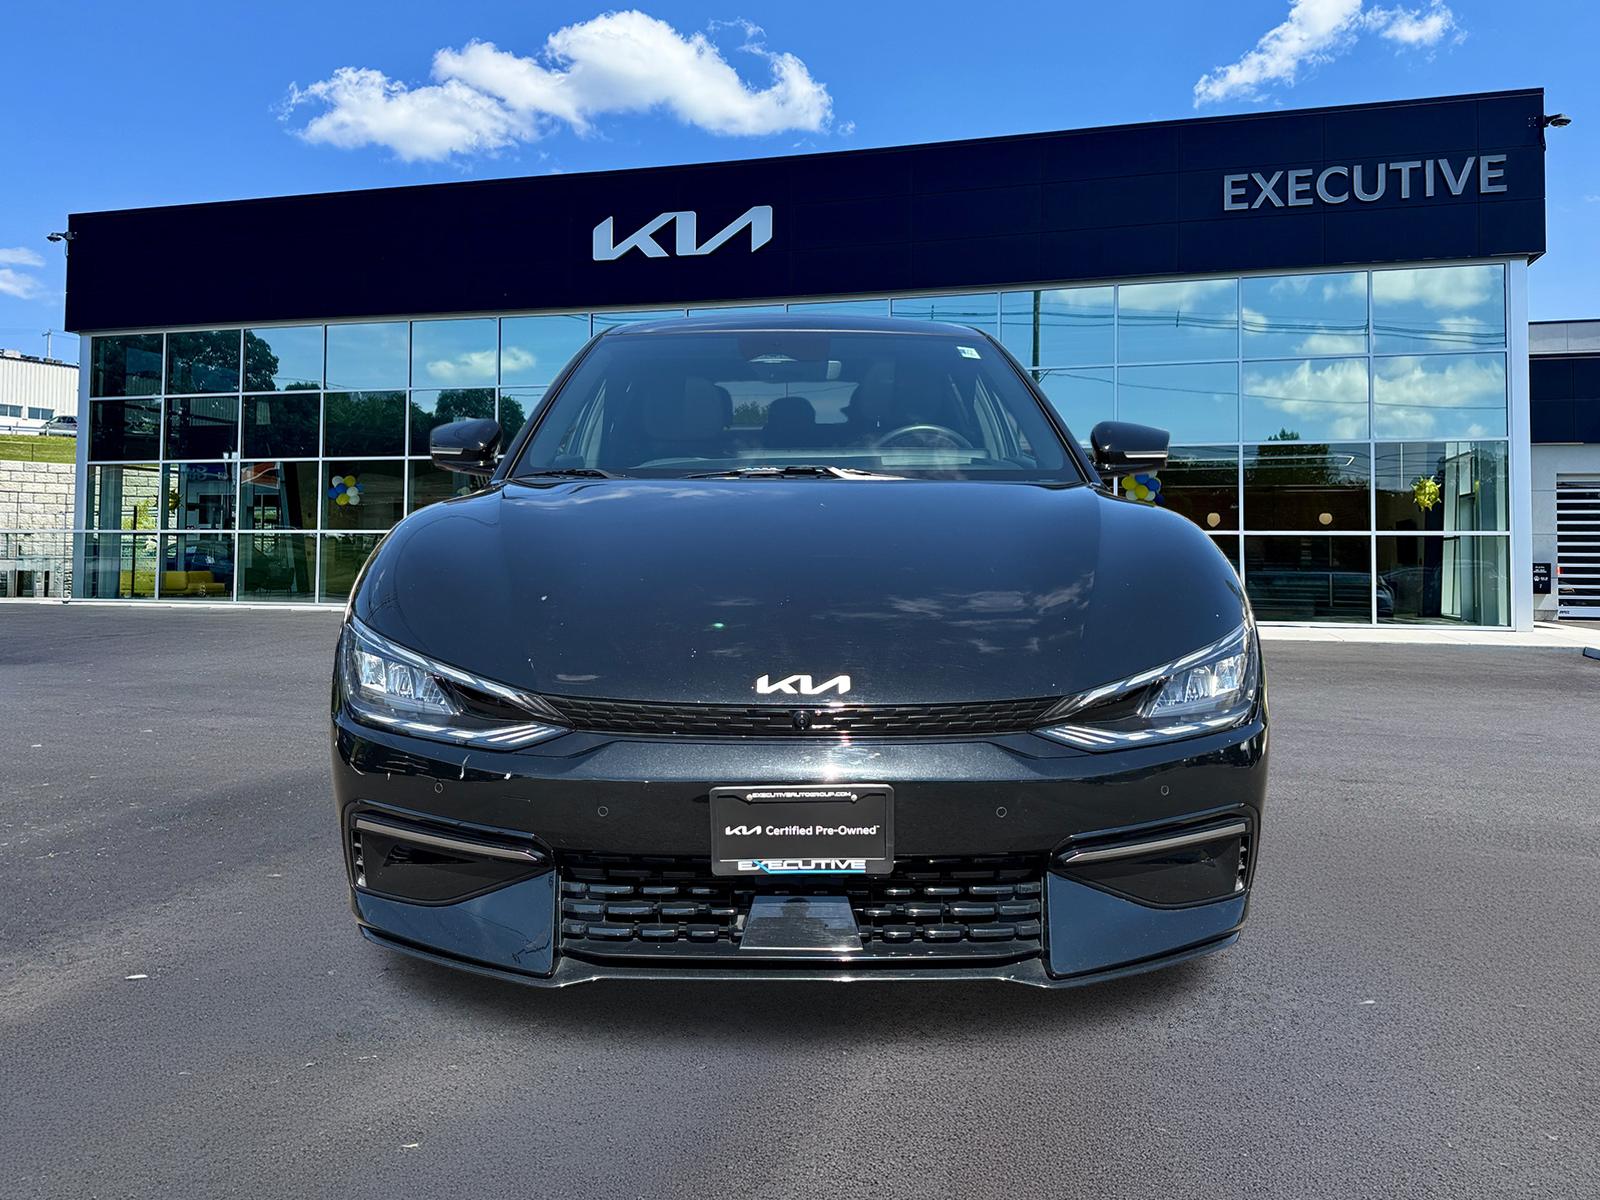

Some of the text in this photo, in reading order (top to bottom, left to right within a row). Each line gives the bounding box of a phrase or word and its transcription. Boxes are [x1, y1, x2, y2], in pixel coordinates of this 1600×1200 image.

[1223, 153, 1509, 212] EXECUTIVE
[592, 205, 773, 261] KIA
[756, 674, 851, 695] KIA
[725, 825, 762, 836] KIA
[765, 825, 813, 836] Certified
[737, 859, 867, 872] EXECUTIVE
